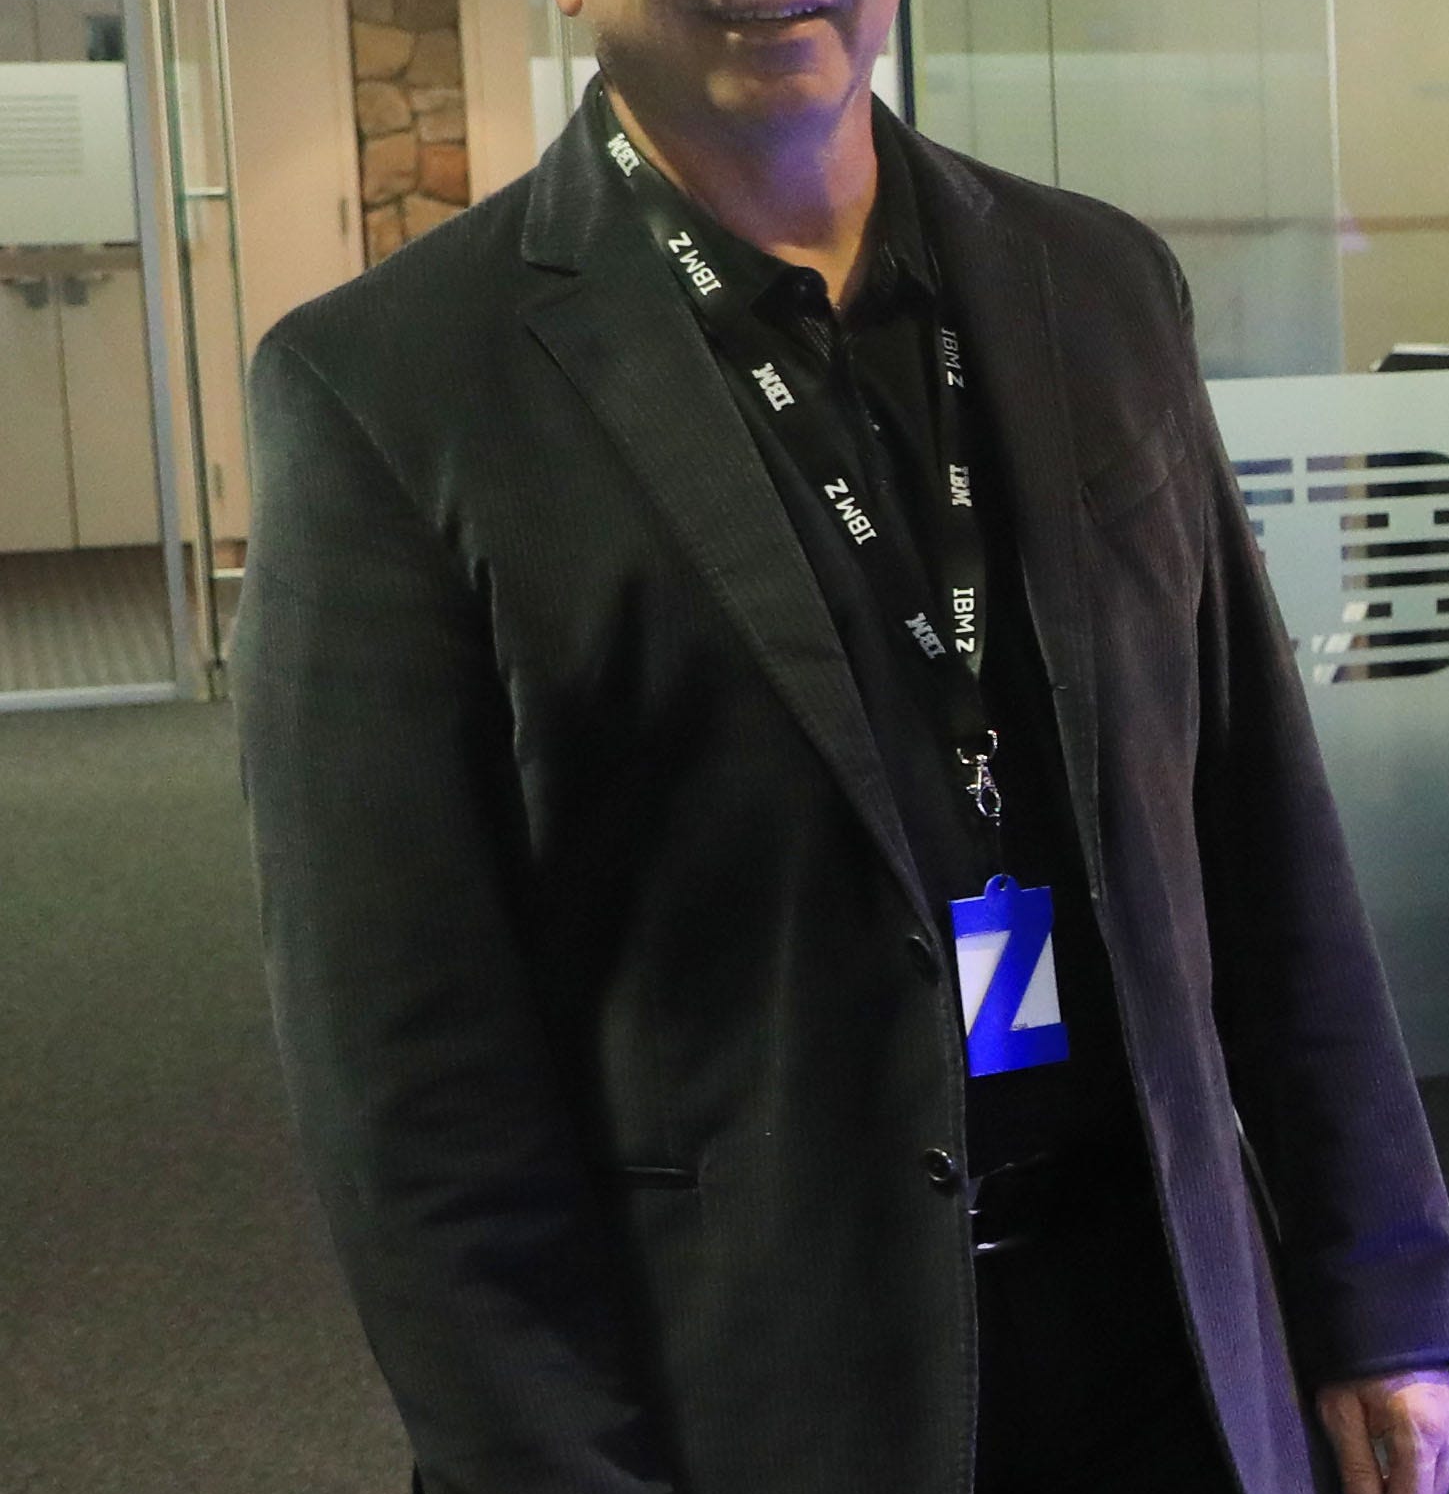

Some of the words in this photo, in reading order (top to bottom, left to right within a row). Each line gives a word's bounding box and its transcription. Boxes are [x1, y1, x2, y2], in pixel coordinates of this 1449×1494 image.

[607, 133, 640, 177] IBM
[668, 231, 693, 253] Z
[680, 249, 722, 295] IBM
[940, 327, 962, 369] IBM
[752, 362, 795, 411] IBM
[947, 370, 964, 388] Z
[824, 478, 848, 500] Z
[949, 463, 972, 507] IBM
[834, 497, 877, 545] IBM
[953, 587, 975, 633] IBM
[905, 612, 946, 659] IBM
[955, 637, 975, 654] Z
